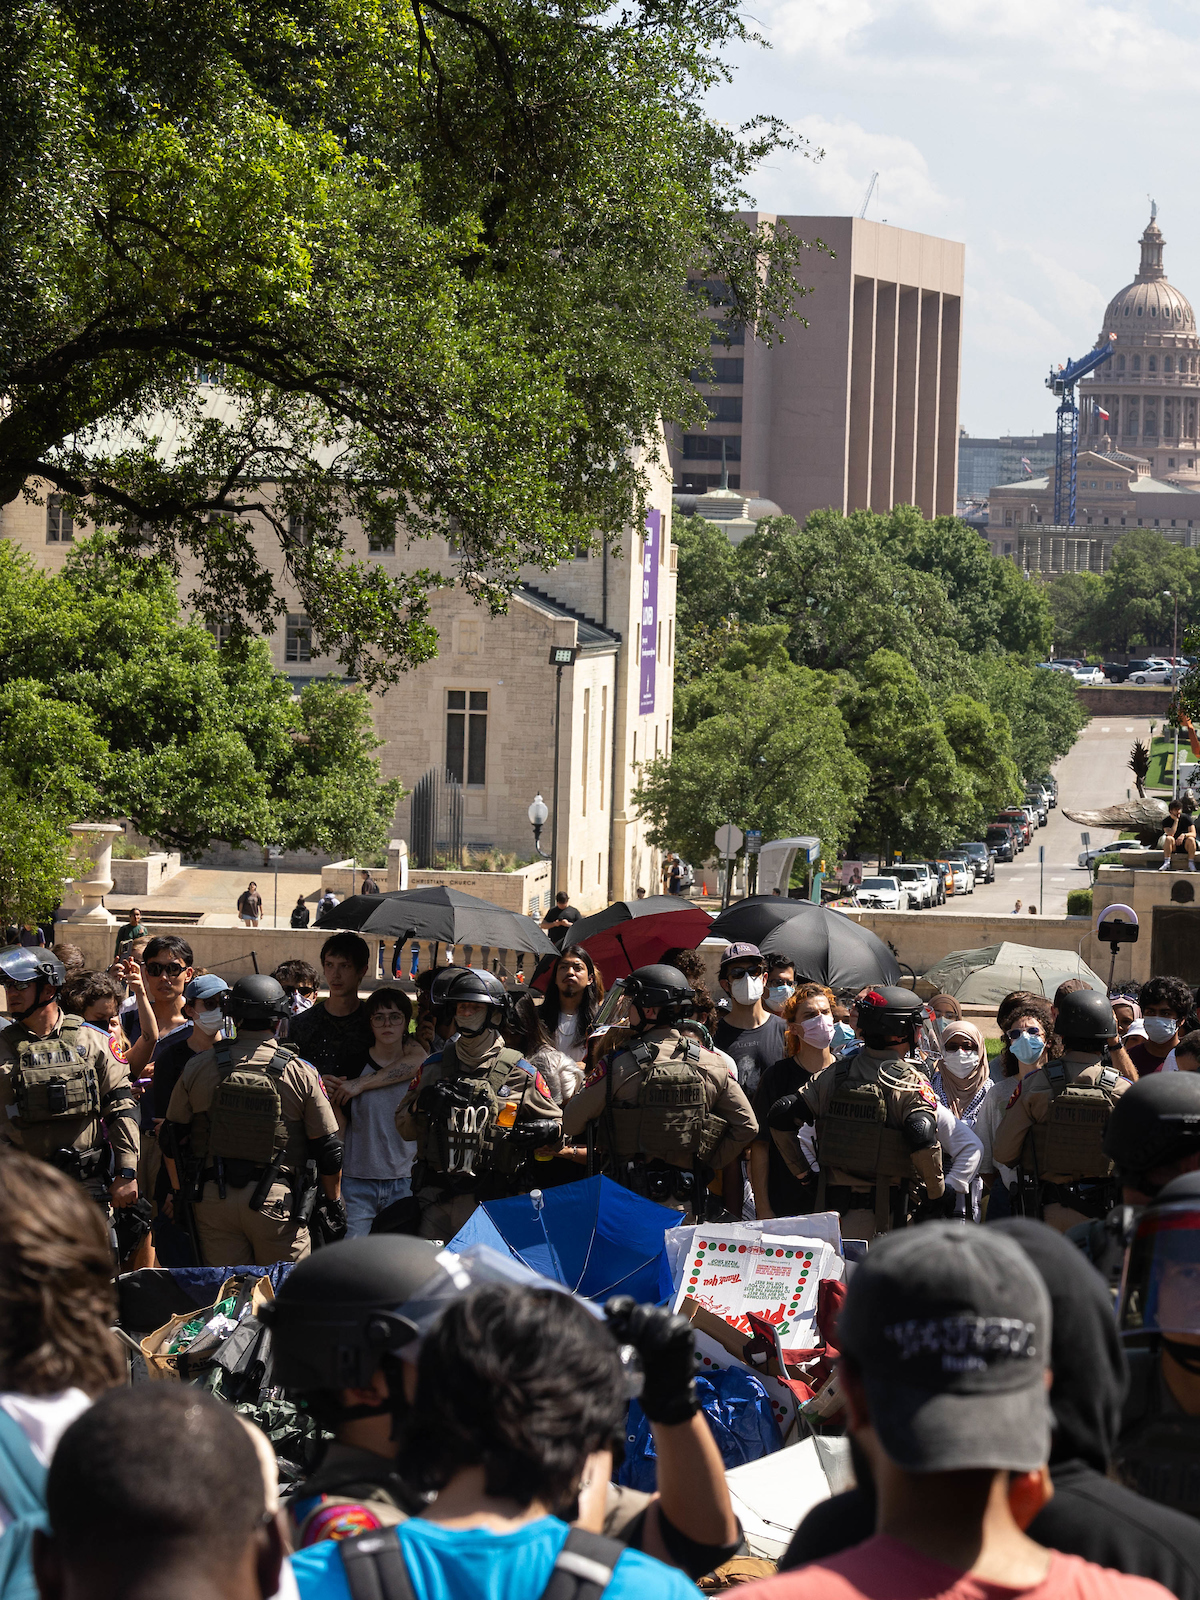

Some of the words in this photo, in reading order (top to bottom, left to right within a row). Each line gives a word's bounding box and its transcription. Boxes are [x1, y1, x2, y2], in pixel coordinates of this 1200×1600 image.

[23, 1053, 46, 1067] STATE
[671, 1088, 700, 1103] TROOPER
[828, 1100, 849, 1117] STATE
[849, 1103, 877, 1119] POLICE
[1055, 1105, 1076, 1122] STATE
[702, 1274, 720, 1287] You
[719, 1273, 742, 1284] Thank
